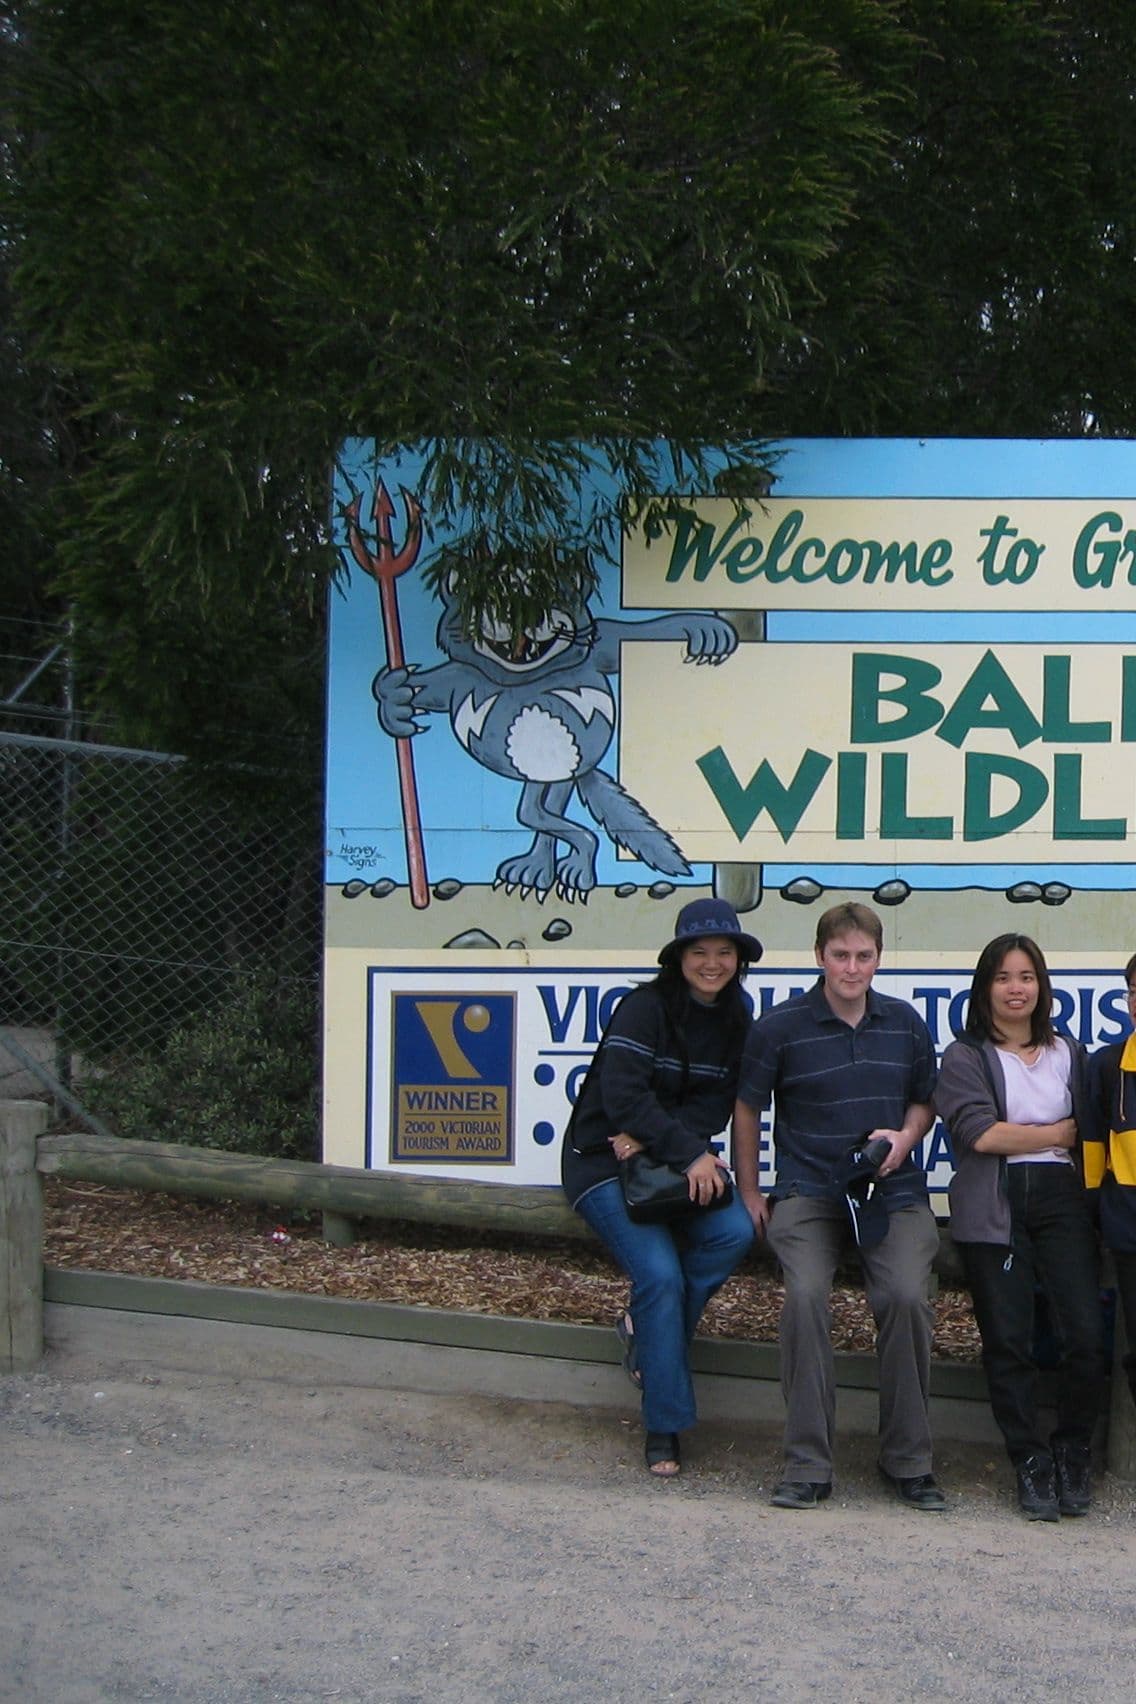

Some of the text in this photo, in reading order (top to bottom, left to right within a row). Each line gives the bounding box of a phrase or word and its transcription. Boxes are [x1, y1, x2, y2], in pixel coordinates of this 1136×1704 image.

[650, 508, 954, 587] Welcome
[978, 514, 1045, 585] to
[340, 843, 378, 858] Harvey
[346, 854, 377, 871] Signs
[404, 1090, 499, 1112] WINNER
[404, 1121, 501, 1135] 2000 VICTORIAN
[403, 1137, 501, 1150] TOURISM AWARD
